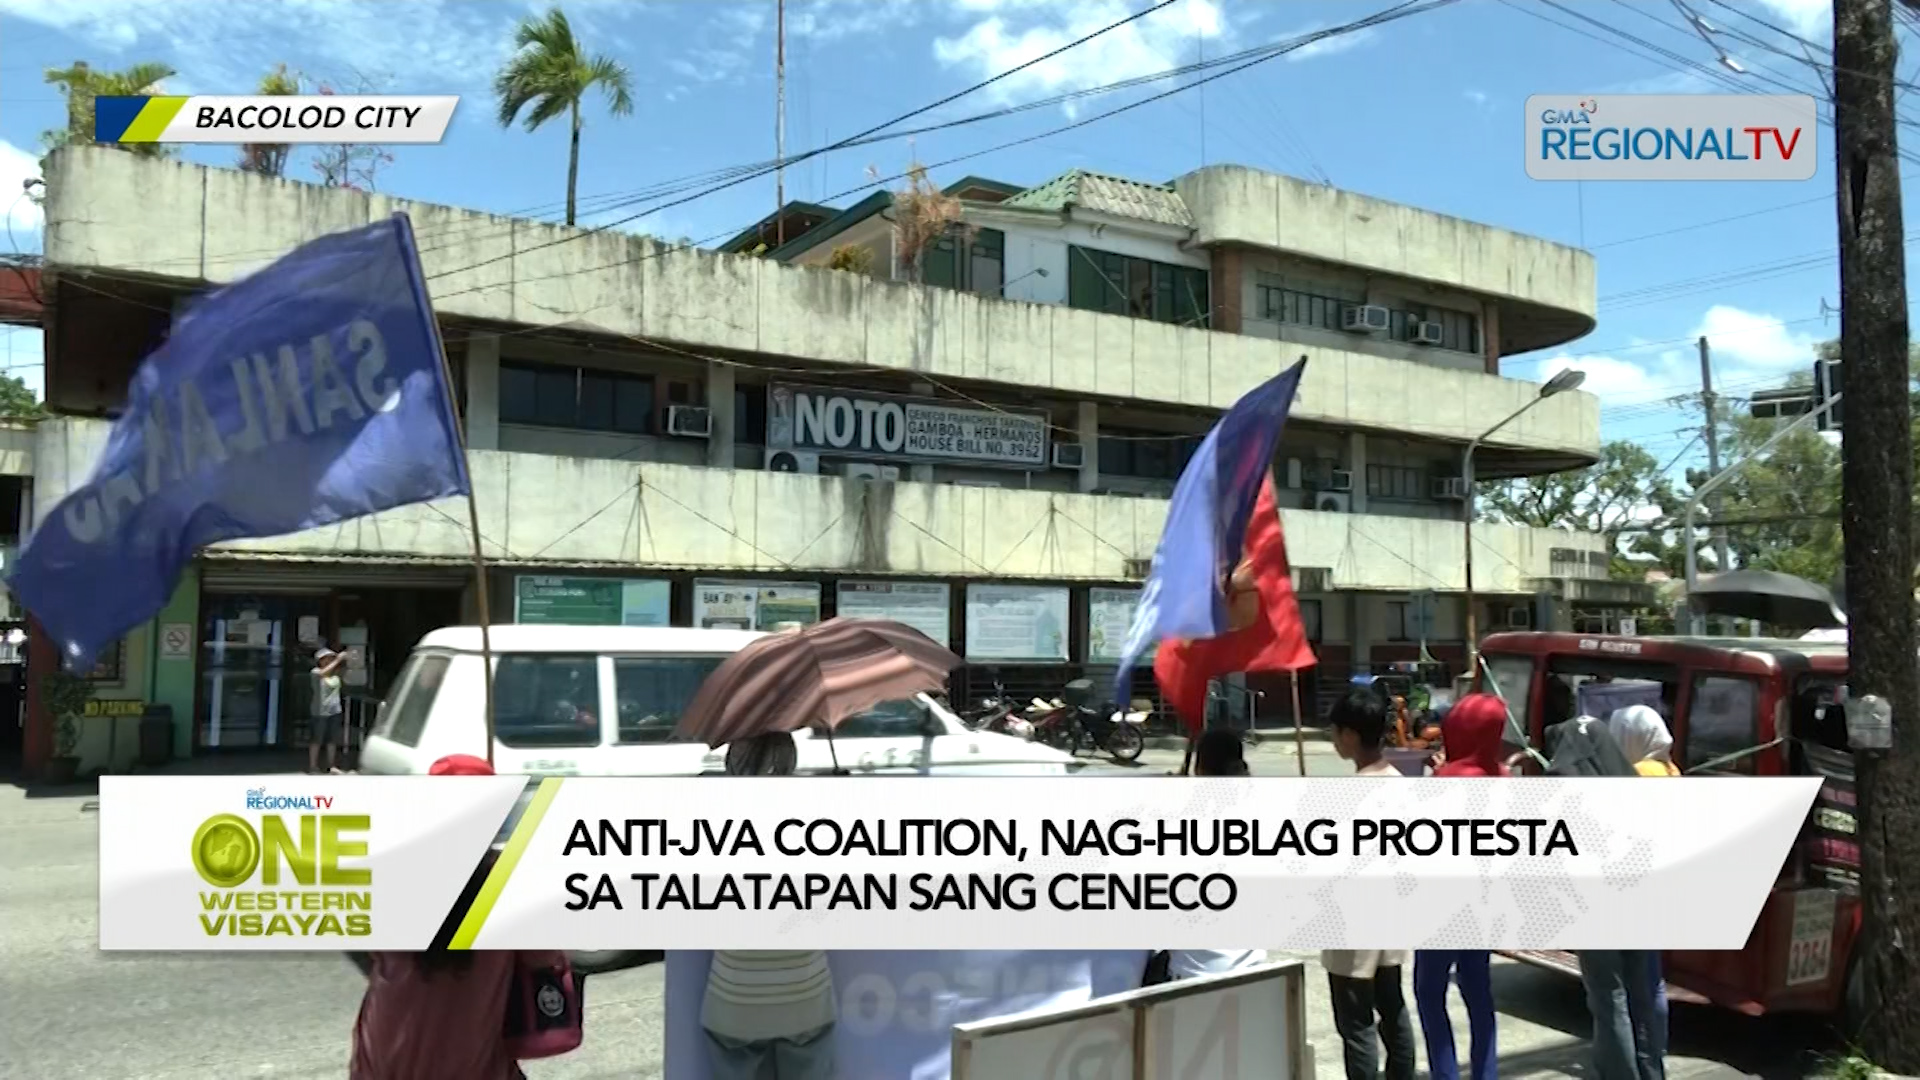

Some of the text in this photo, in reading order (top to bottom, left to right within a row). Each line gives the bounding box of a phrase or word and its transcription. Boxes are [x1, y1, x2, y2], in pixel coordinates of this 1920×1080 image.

[908, 421, 963, 438] GAMBOA
[974, 427, 1041, 444] HERMANOS
[909, 435, 953, 452] HOUSE
[956, 438, 981, 455] BILL
